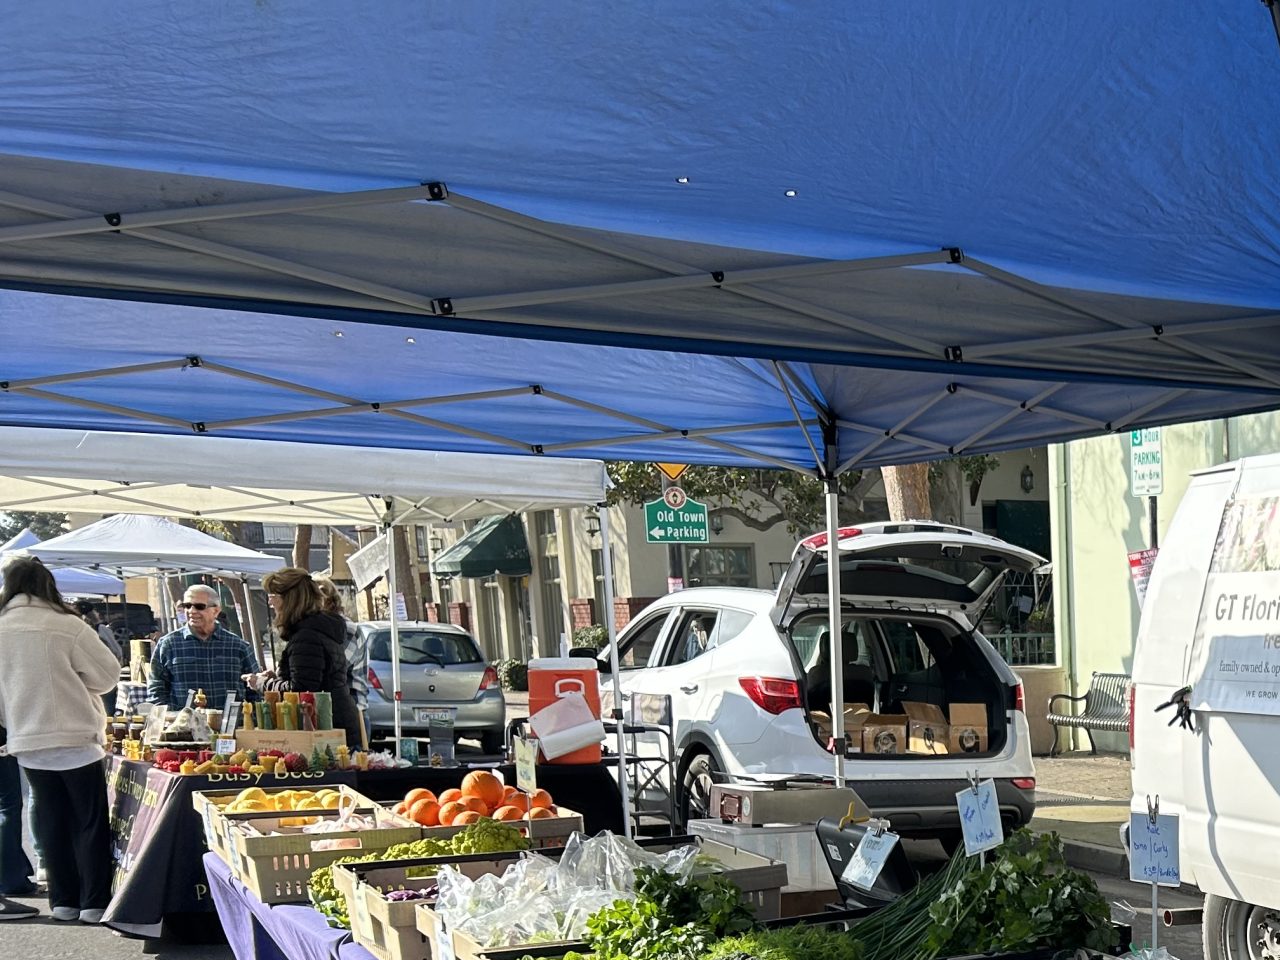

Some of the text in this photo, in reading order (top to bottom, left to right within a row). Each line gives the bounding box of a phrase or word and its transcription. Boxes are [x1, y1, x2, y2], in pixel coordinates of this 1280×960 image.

[1144, 431, 1159, 442] HOUR
[1134, 451, 1160, 465] PARKING
[657, 511, 704, 522] Old Town
[667, 526, 705, 540] Parking
[1216, 594, 1238, 620] GT
[1219, 660, 1239, 675] family
[1240, 662, 1262, 673] owned
[1264, 663, 1270, 673] &
[1246, 690, 1255, 698] WE
[1258, 691, 1278, 699] GROW
